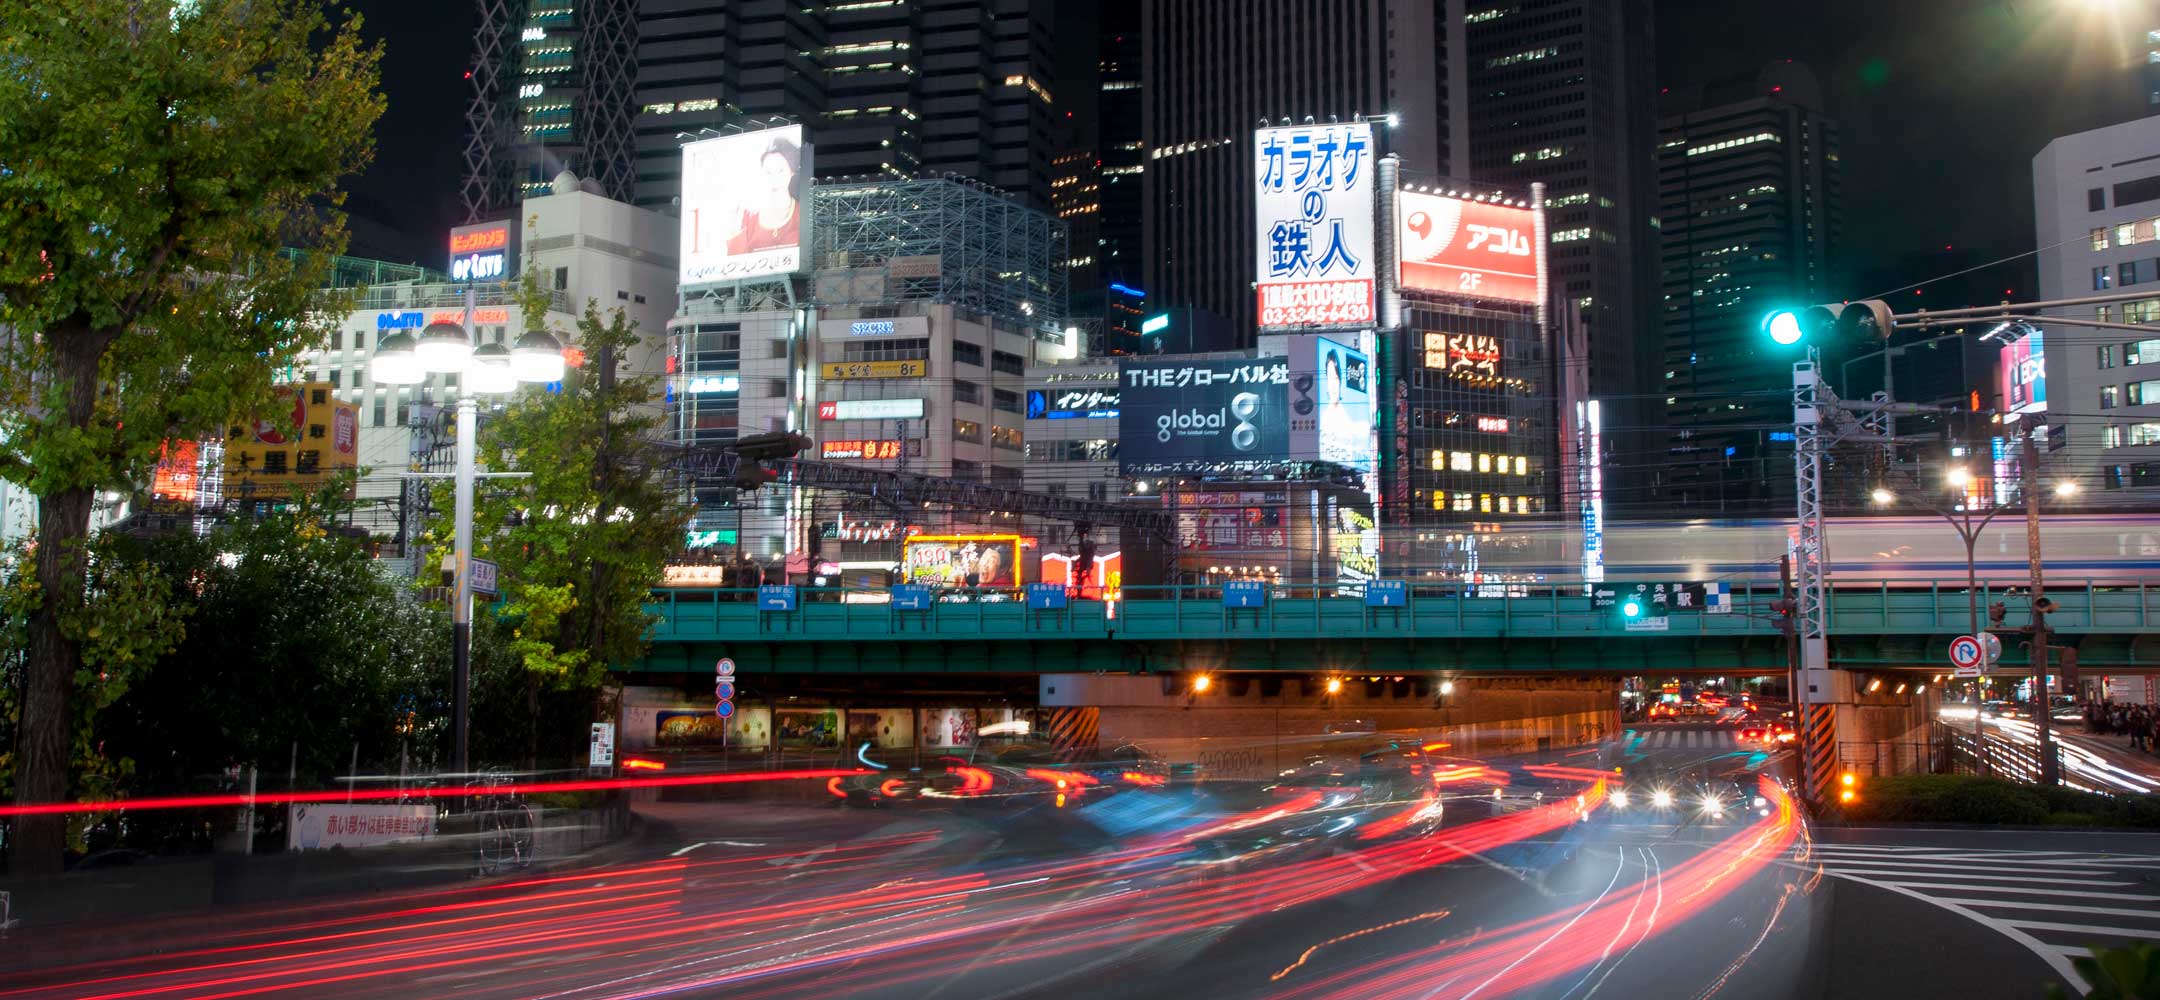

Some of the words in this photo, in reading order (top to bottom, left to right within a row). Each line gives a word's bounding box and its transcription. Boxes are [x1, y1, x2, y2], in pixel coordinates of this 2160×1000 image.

[1261, 130, 1367, 191] カラオケ
[1302, 188, 1326, 223] の
[452, 229, 506, 250] ビックカメラ
[1270, 220, 1359, 275] 鉄人
[1466, 224, 1530, 256] アコム
[1460, 272, 1482, 290] 2F
[1263, 305, 1370, 324] 03-3345-6430
[900, 363, 917, 376] 8F
[1126, 364, 1290, 388] THEグローバル社
[1157, 407, 1226, 442] global
[1127, 463, 1181, 472] ウィルローズ
